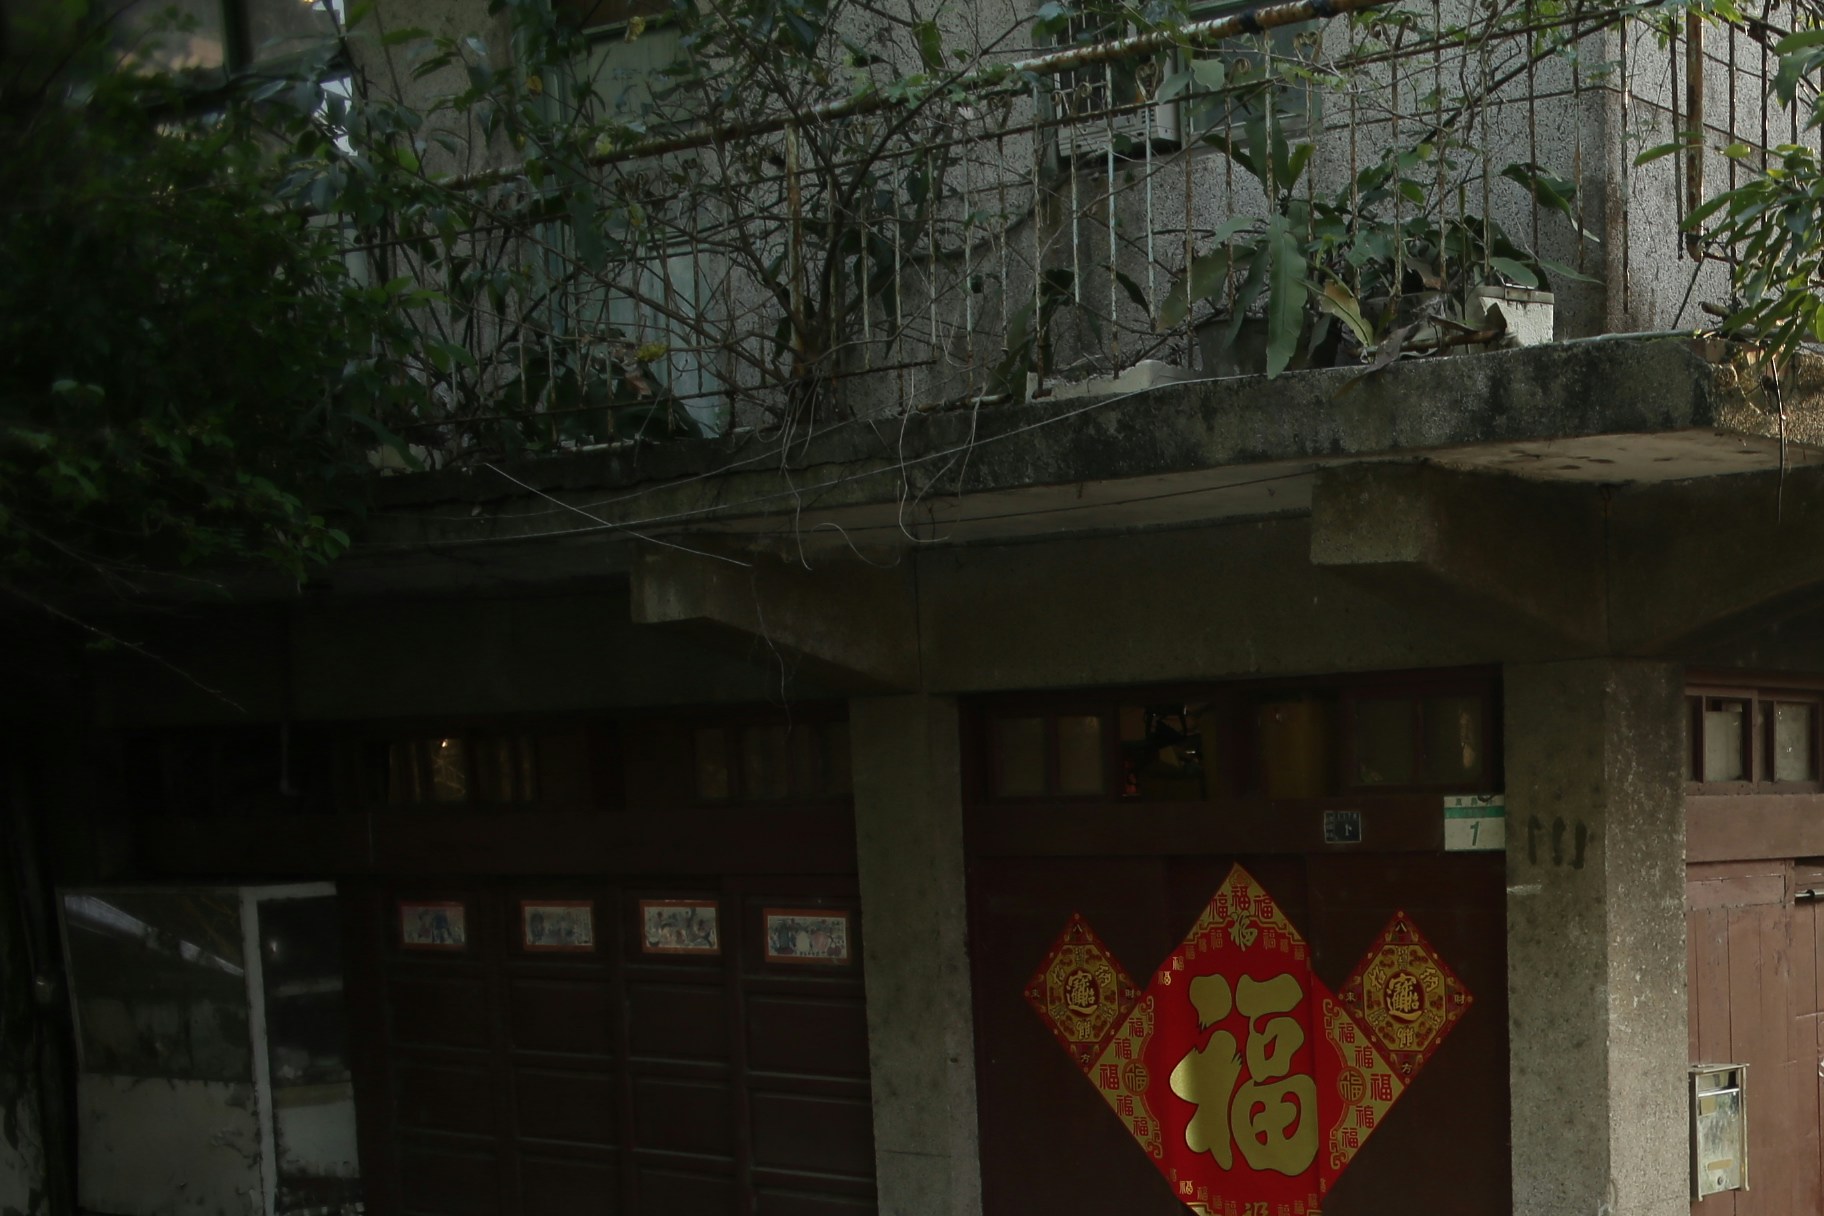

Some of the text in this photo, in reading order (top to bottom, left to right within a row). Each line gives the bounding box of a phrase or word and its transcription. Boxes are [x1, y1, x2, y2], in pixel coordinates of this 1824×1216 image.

[1470, 821, 1480, 846] 1
[1209, 893, 1228, 920] 福
[1231, 886, 1250, 910] 福
[1254, 894, 1273, 919] 福
[1129, 1018, 1144, 1037] 福
[1339, 1023, 1354, 1044] 福
[1114, 1038, 1132, 1059] 福
[1355, 1046, 1373, 1069] 福
[1099, 1064, 1119, 1090] 福
[1125, 1063, 1147, 1091] 福
[1170, 973, 1319, 1177] 福
[1340, 1071, 1362, 1101] 福
[1370, 1074, 1393, 1101] 福
[1116, 1095, 1133, 1116] 福
[1356, 1105, 1374, 1128] 福
[1133, 1117, 1148, 1136] 福
[1342, 1128, 1358, 1148] 福
